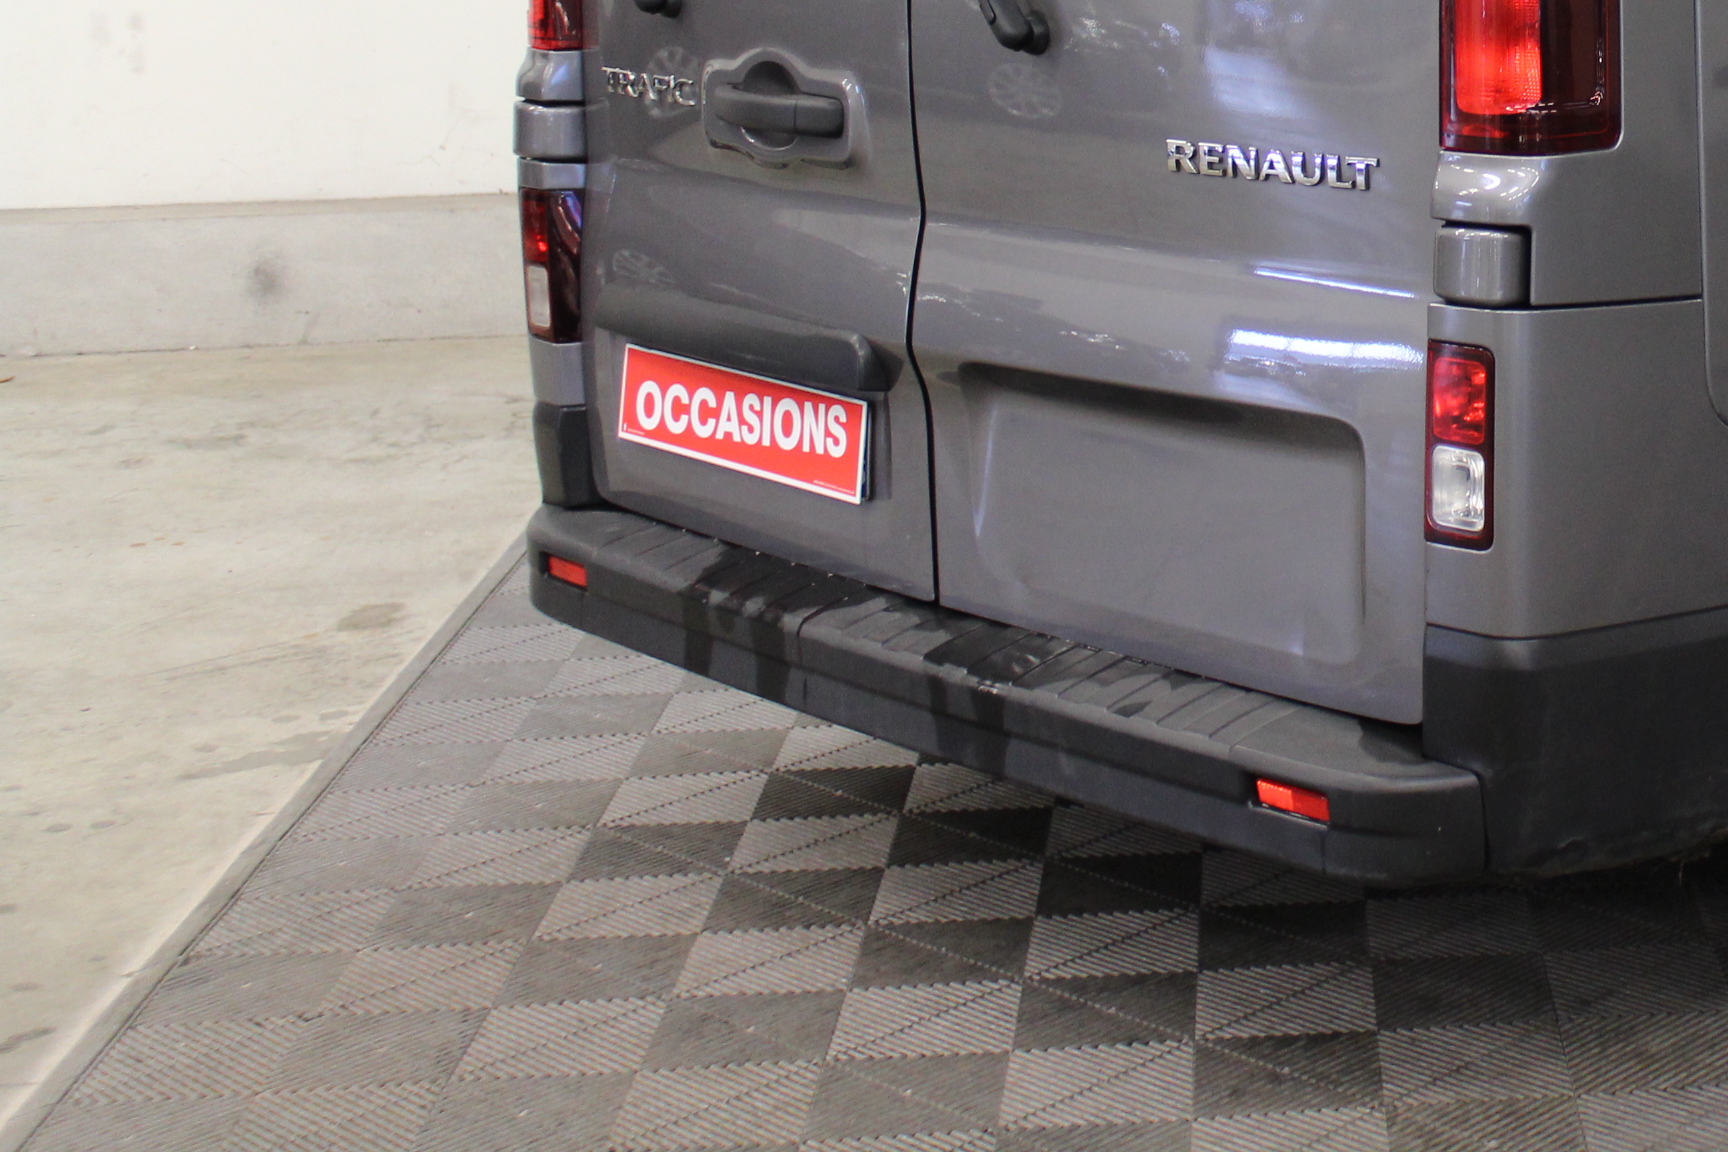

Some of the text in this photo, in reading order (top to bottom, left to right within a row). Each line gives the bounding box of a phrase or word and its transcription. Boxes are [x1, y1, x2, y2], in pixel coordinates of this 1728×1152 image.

[602, 66, 696, 106] TRAFIC
[1165, 138, 1380, 191] RENAULT
[635, 380, 847, 458] OCCASIONS
